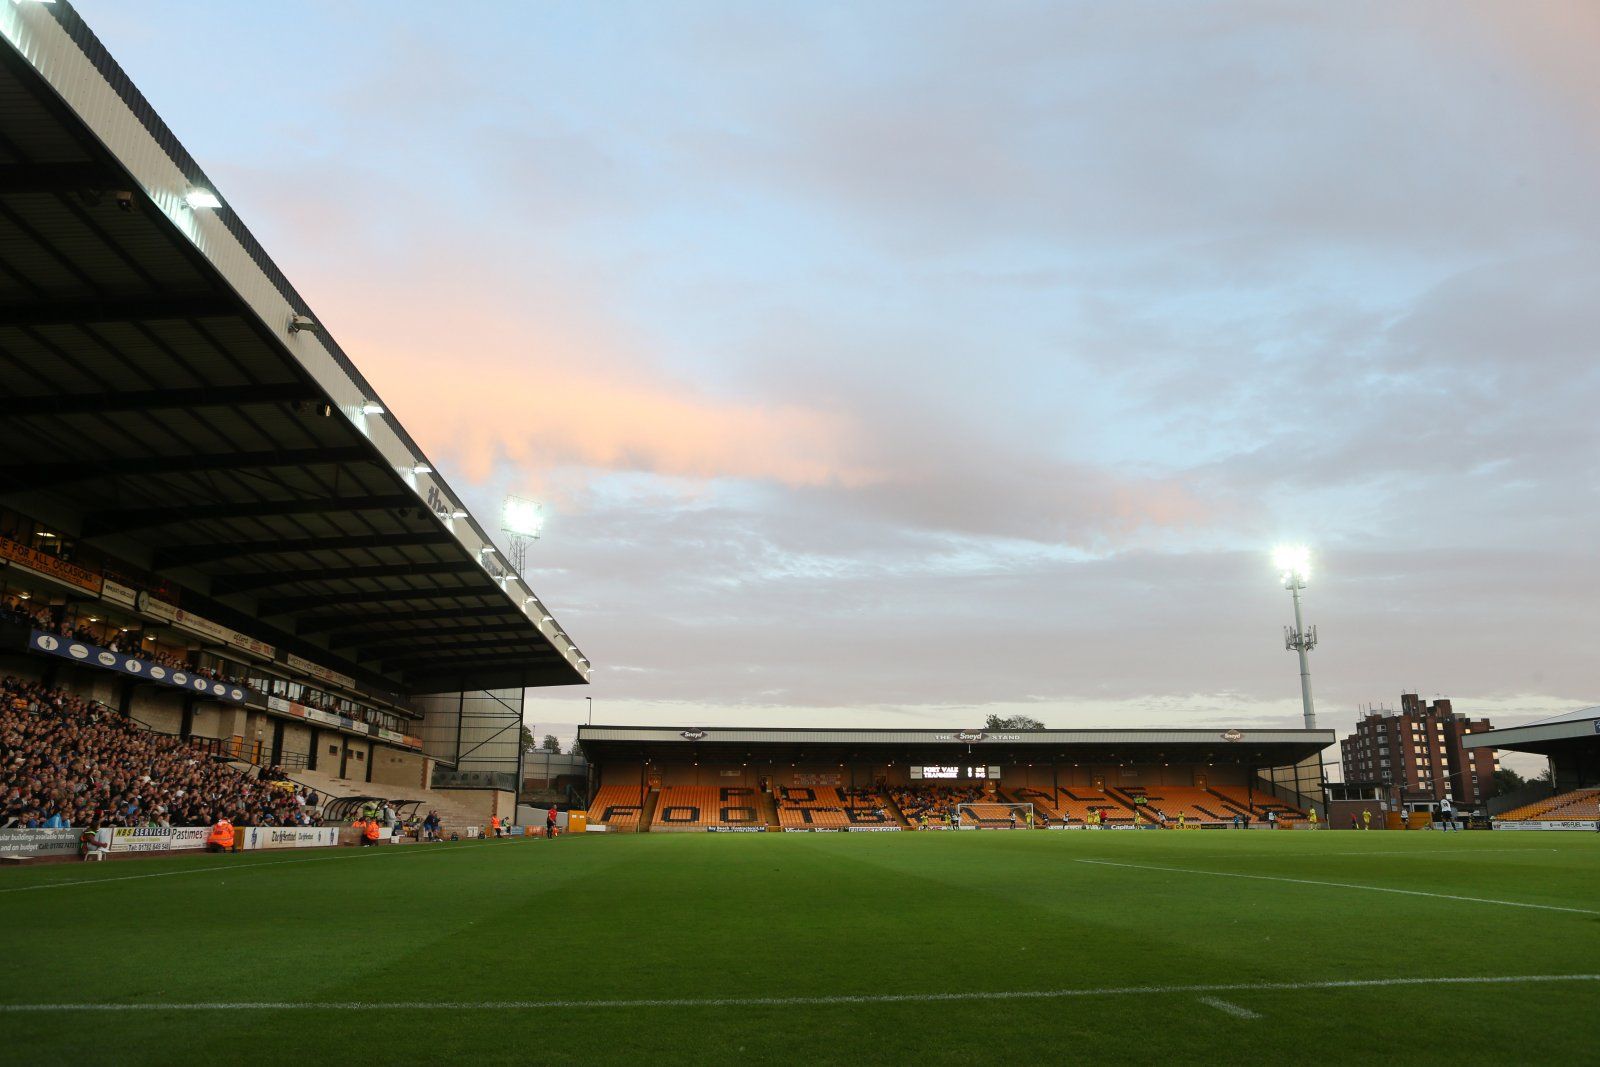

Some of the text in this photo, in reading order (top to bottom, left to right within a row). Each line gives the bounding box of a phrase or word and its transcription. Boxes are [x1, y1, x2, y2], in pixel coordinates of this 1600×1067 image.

[13, 543, 29, 556] FOR
[33, 553, 48, 566] ALL
[960, 731, 982, 741] Sneyd
[134, 828, 170, 836] SERVICES
[171, 828, 203, 840] Pastimes
[12, 833, 35, 843] buildings
[35, 833, 57, 841] available
[1, 843, 12, 851] and
[20, 843, 39, 852] budget
